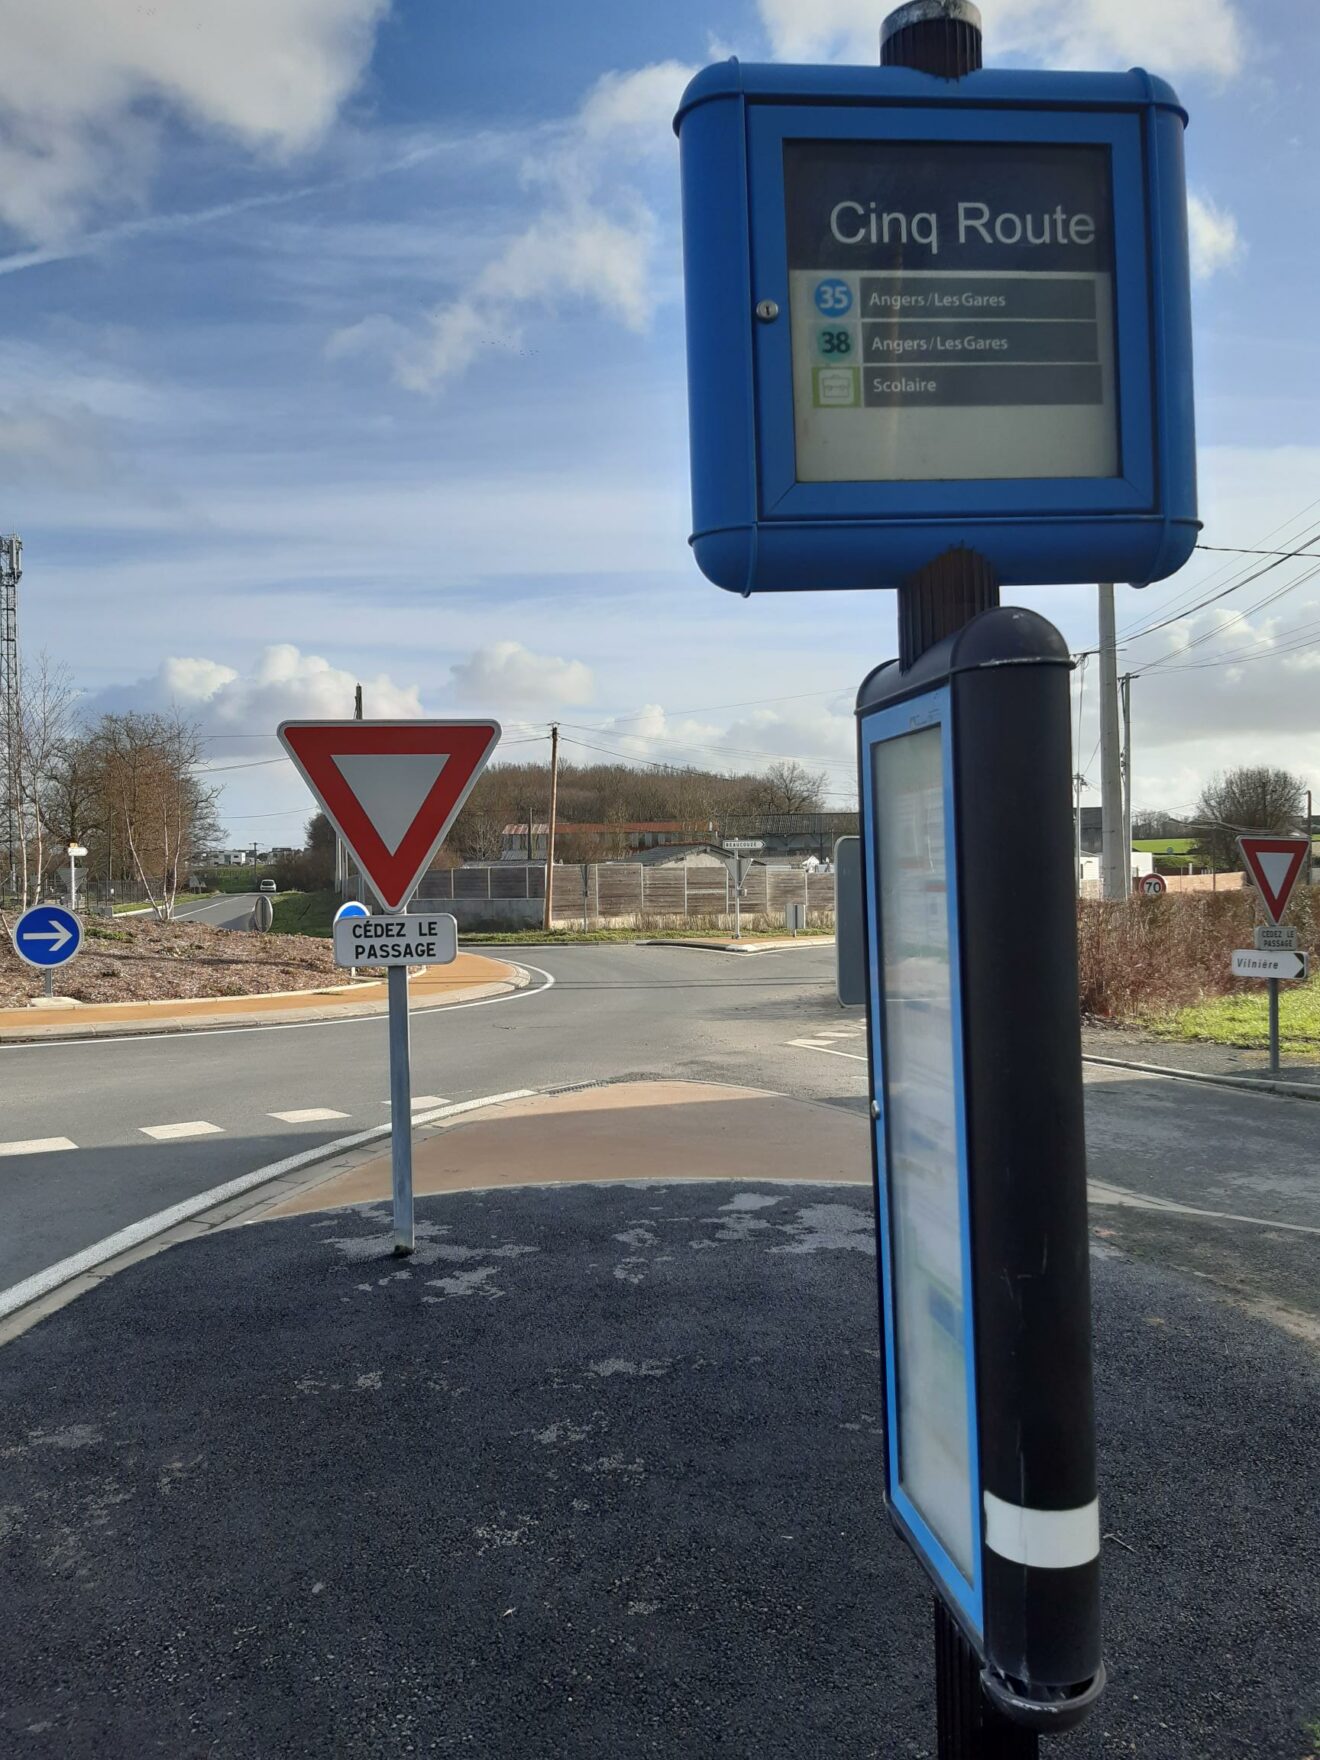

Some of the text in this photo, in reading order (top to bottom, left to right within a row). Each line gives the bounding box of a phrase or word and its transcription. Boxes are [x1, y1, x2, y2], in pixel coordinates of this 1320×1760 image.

[830, 201, 1096, 254] Cinq Route
[819, 286, 848, 308] 35
[822, 331, 850, 353] 38
[873, 378, 937, 392] Scolaire
[1146, 882, 1161, 893] 70
[352, 920, 439, 938] CÉDEZ LE
[1286, 930, 1296, 938] LE
[355, 942, 436, 959] PASSAGE
[1263, 939, 1293, 948] PASSAGE
[1237, 958, 1279, 969] Vilnière
